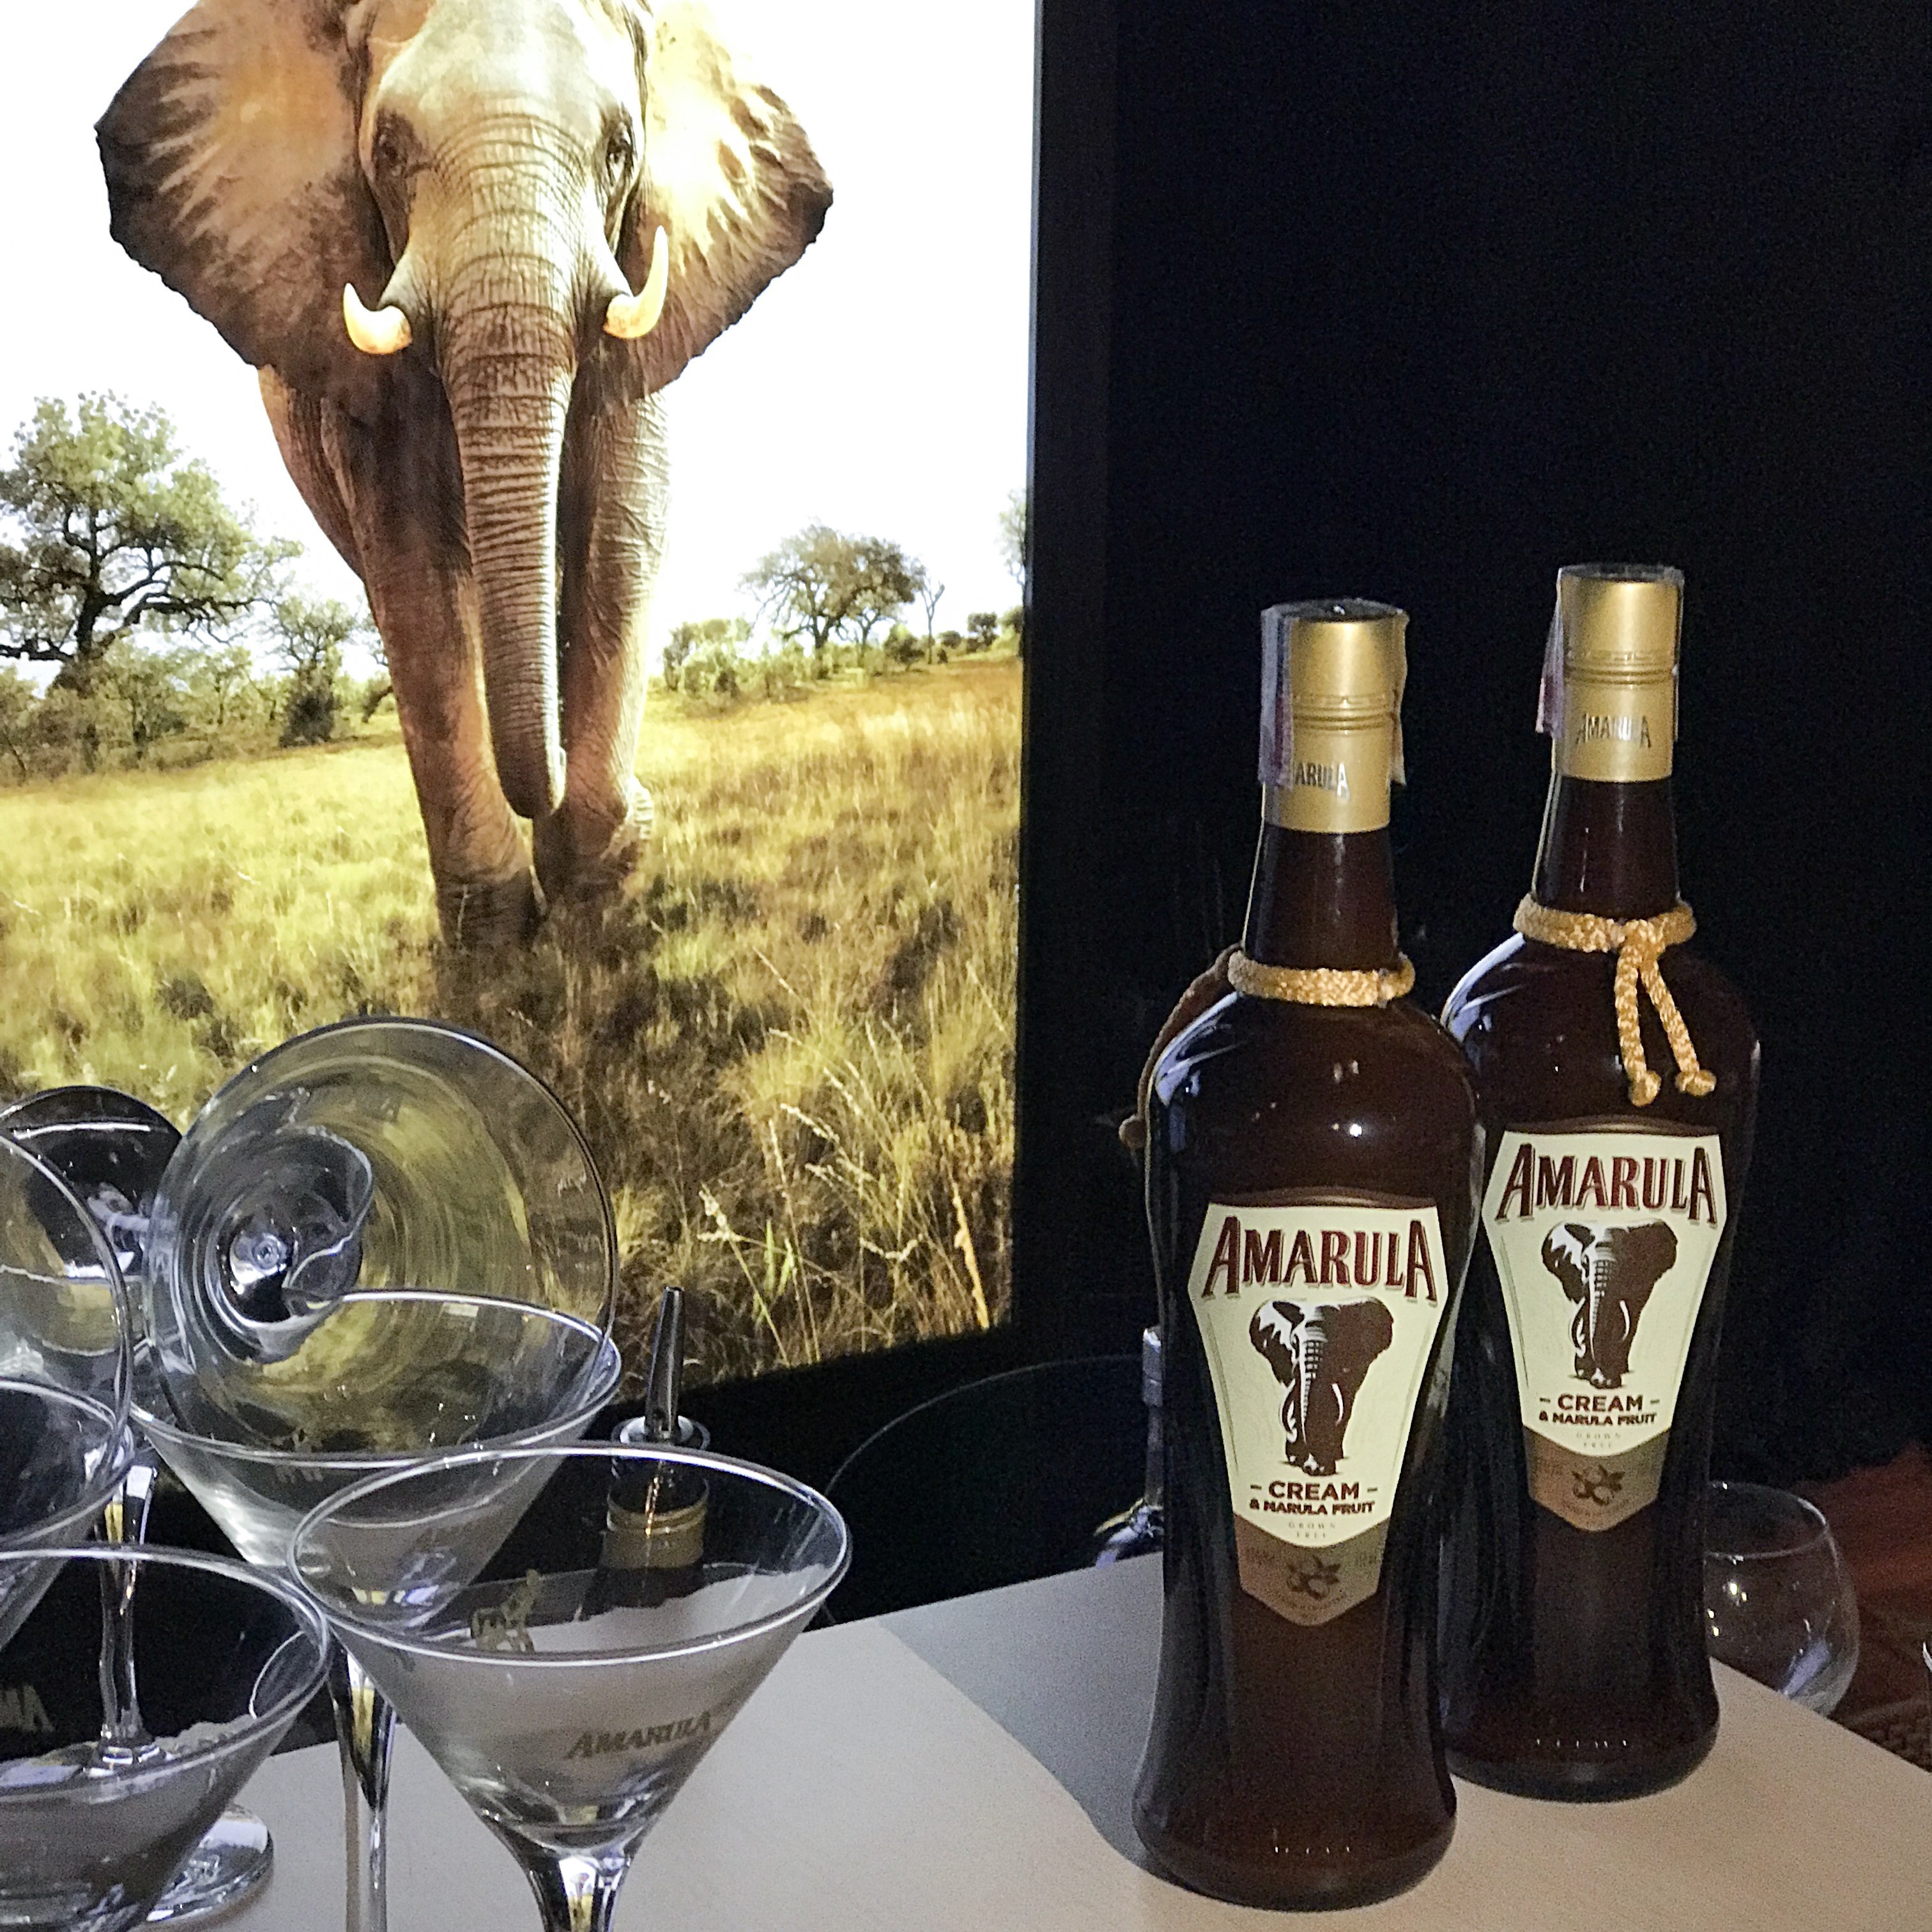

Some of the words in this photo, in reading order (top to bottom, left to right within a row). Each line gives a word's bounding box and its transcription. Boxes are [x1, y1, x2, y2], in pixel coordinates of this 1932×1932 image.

[1574, 713, 1652, 749] AMAUA
[1495, 1143, 1718, 1229] AMARULA
[1201, 1215, 1438, 1307] AMARULA
[1558, 1393, 1644, 1412] CREAM
[1552, 1412, 1613, 1426] MARULA
[1617, 1413, 1657, 1425] FRUIT
[1268, 1480, 1360, 1501] CREAM
[1263, 1501, 1328, 1515] MARULA
[1332, 1501, 1376, 1515] FRUIT
